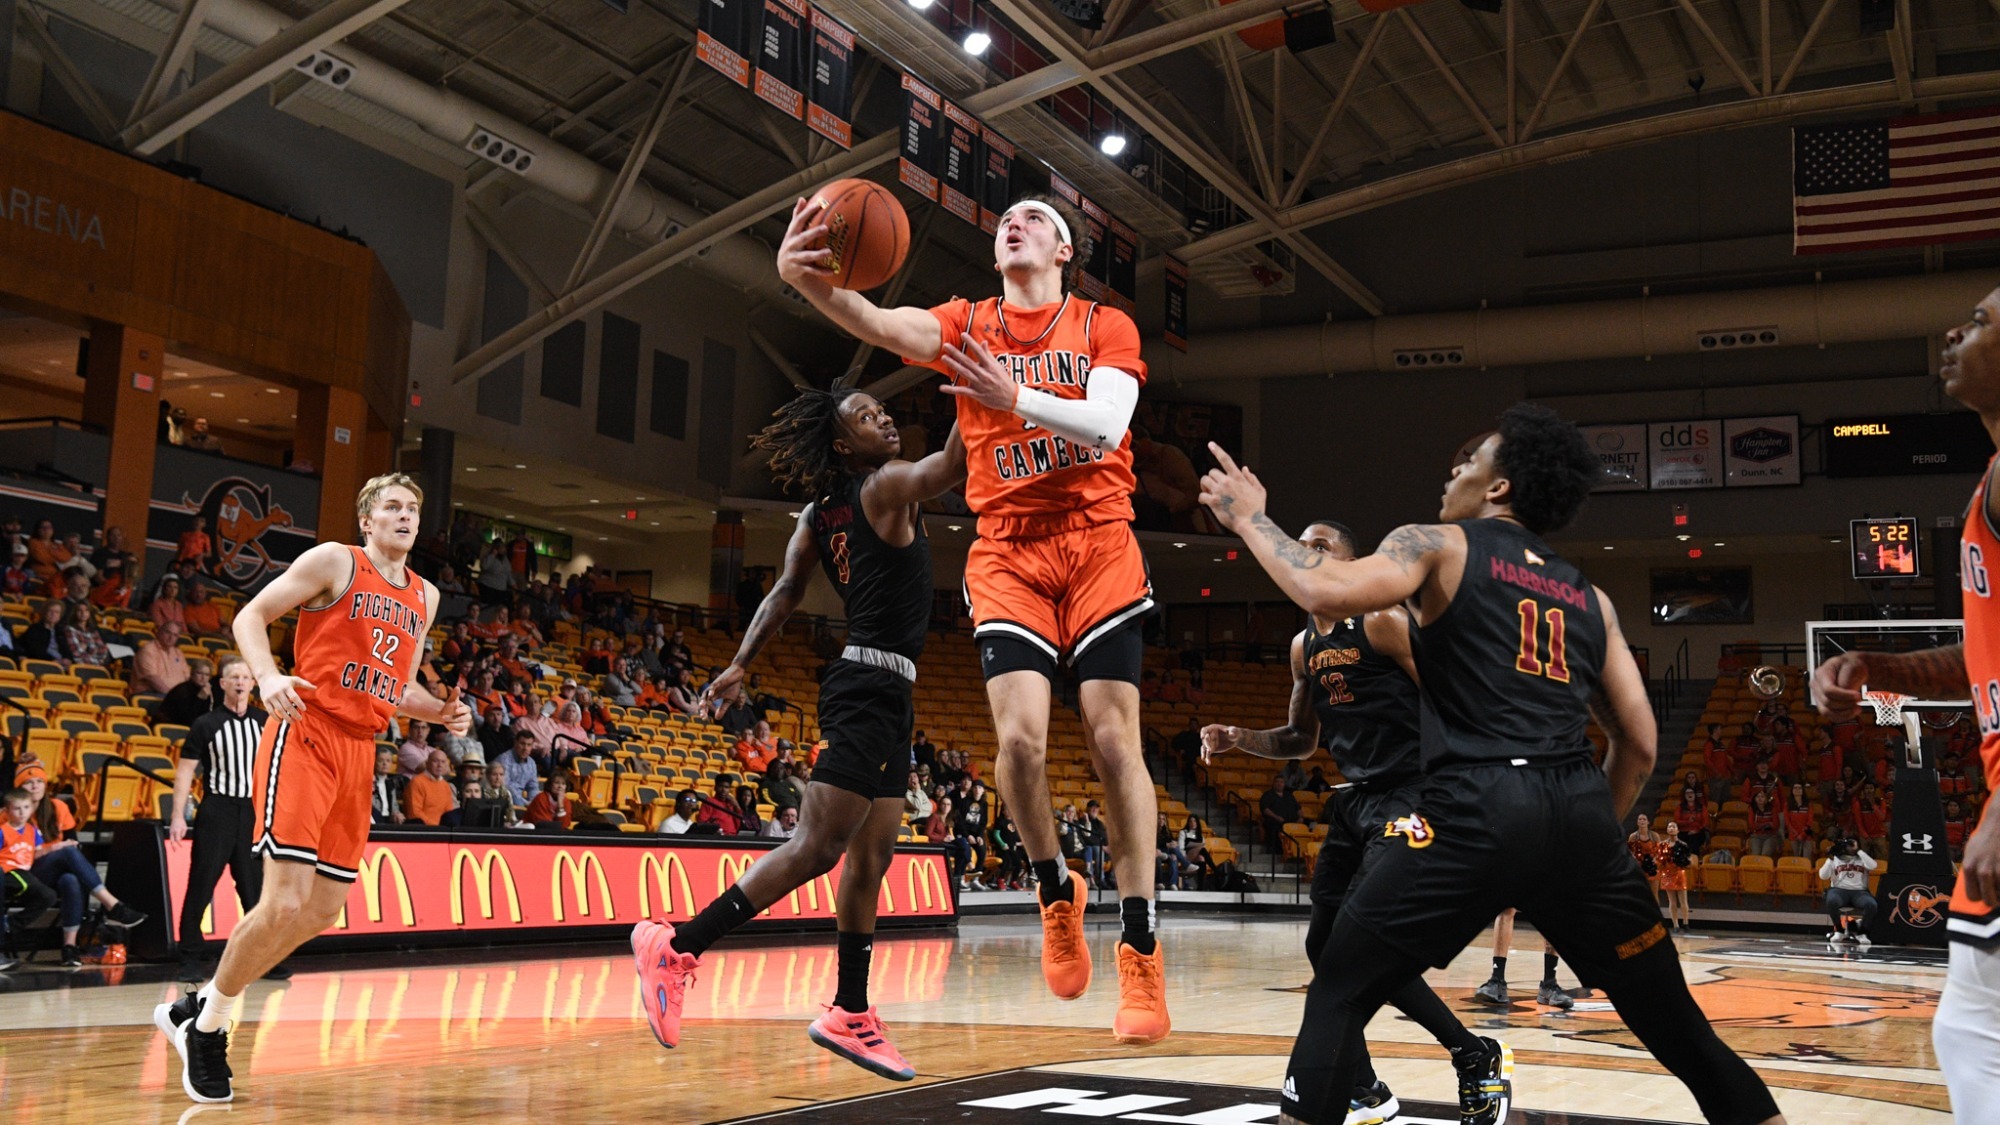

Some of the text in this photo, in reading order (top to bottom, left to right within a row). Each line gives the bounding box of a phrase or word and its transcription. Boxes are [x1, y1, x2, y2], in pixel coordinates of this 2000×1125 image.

[812, 11, 852, 48] CAMPBELL
[902, 76, 939, 106] CAMPBELL
[945, 104, 978, 132] CAMPBELL
[982, 130, 1014, 157] CAMPBELL
[1052, 177, 1078, 204] CAMPBELL
[0, 186, 106, 250] RENA
[1082, 199, 1108, 226] CAMPBELL
[997, 350, 1090, 389] GHTING
[1660, 425, 1709, 447] dds
[1738, 437, 1785, 448] Hampton
[1834, 424, 1890, 437] CAMPBELL
[1600, 452, 1640, 464] RNETT
[1664, 456, 1690, 464] xerox
[1748, 448, 1769, 457] Inn
[1913, 454, 1947, 464] PERIOD
[1742, 468, 1783, 477] Dunn, NC
[1870, 525, 1909, 542] 5:22
[1490, 556, 1587, 611] HARRISON
[371, 627, 400, 667] 22
[1516, 598, 1570, 684] 11
[1321, 672, 1354, 705] 12
